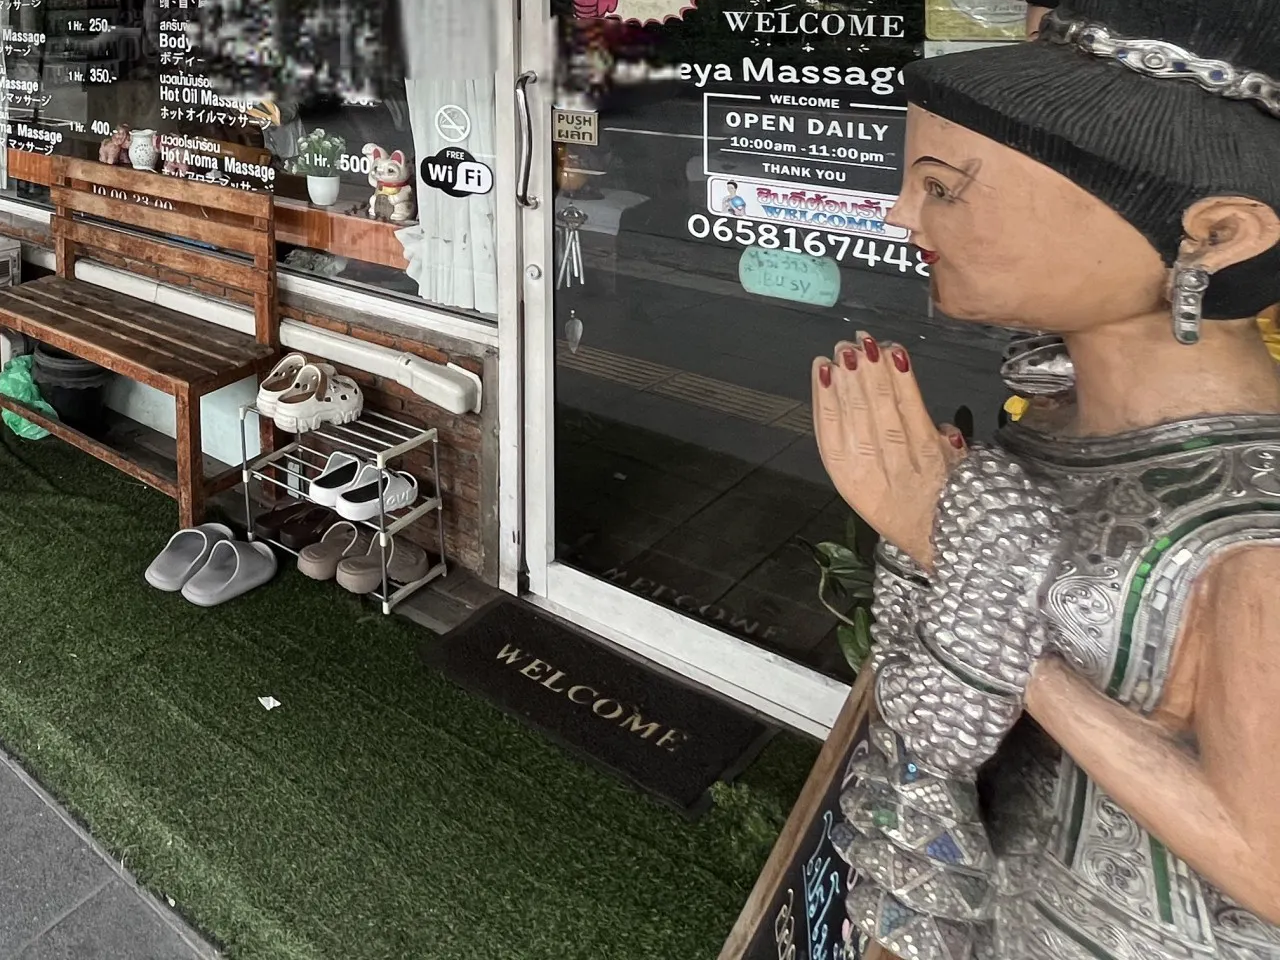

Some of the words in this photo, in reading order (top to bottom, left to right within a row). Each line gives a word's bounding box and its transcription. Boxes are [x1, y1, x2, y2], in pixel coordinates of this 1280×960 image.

[73, 21, 85, 31] Hr.
[89, 18, 116, 32] 250.-
[723, 8, 905, 38] WELCOME
[3, 29, 46, 46] Massage
[159, 33, 192, 52] Body
[74, 71, 85, 81] Hr.
[89, 69, 117, 83] 350.-
[679, 61, 732, 88] eya
[160, 86, 180, 102] Hot
[182, 87, 198, 105] Oil
[201, 89, 253, 112] Massage
[770, 94, 840, 108] WELCOME
[75, 122, 86, 132] Hr.
[557, 114, 592, 126] PUSH
[726, 112, 796, 133] OPEN
[807, 118, 889, 141] DAILY
[17, 124, 63, 144] Massage
[557, 126, 593, 142] ผลัก
[304, 153, 310, 164] 1
[314, 153, 330, 167] Hr.
[446, 150, 464, 160] FREE
[730, 136, 796, 153] 10:00am
[808, 144, 885, 165] 11:00pm
[161, 145, 180, 163] Hot
[183, 150, 218, 170] Aroma
[225, 156, 275, 183] Massage
[763, 163, 811, 179] THANK
[816, 169, 846, 182] YOU
[761, 205, 886, 234] WELCOME
[495, 642, 688, 753] WELCOME
